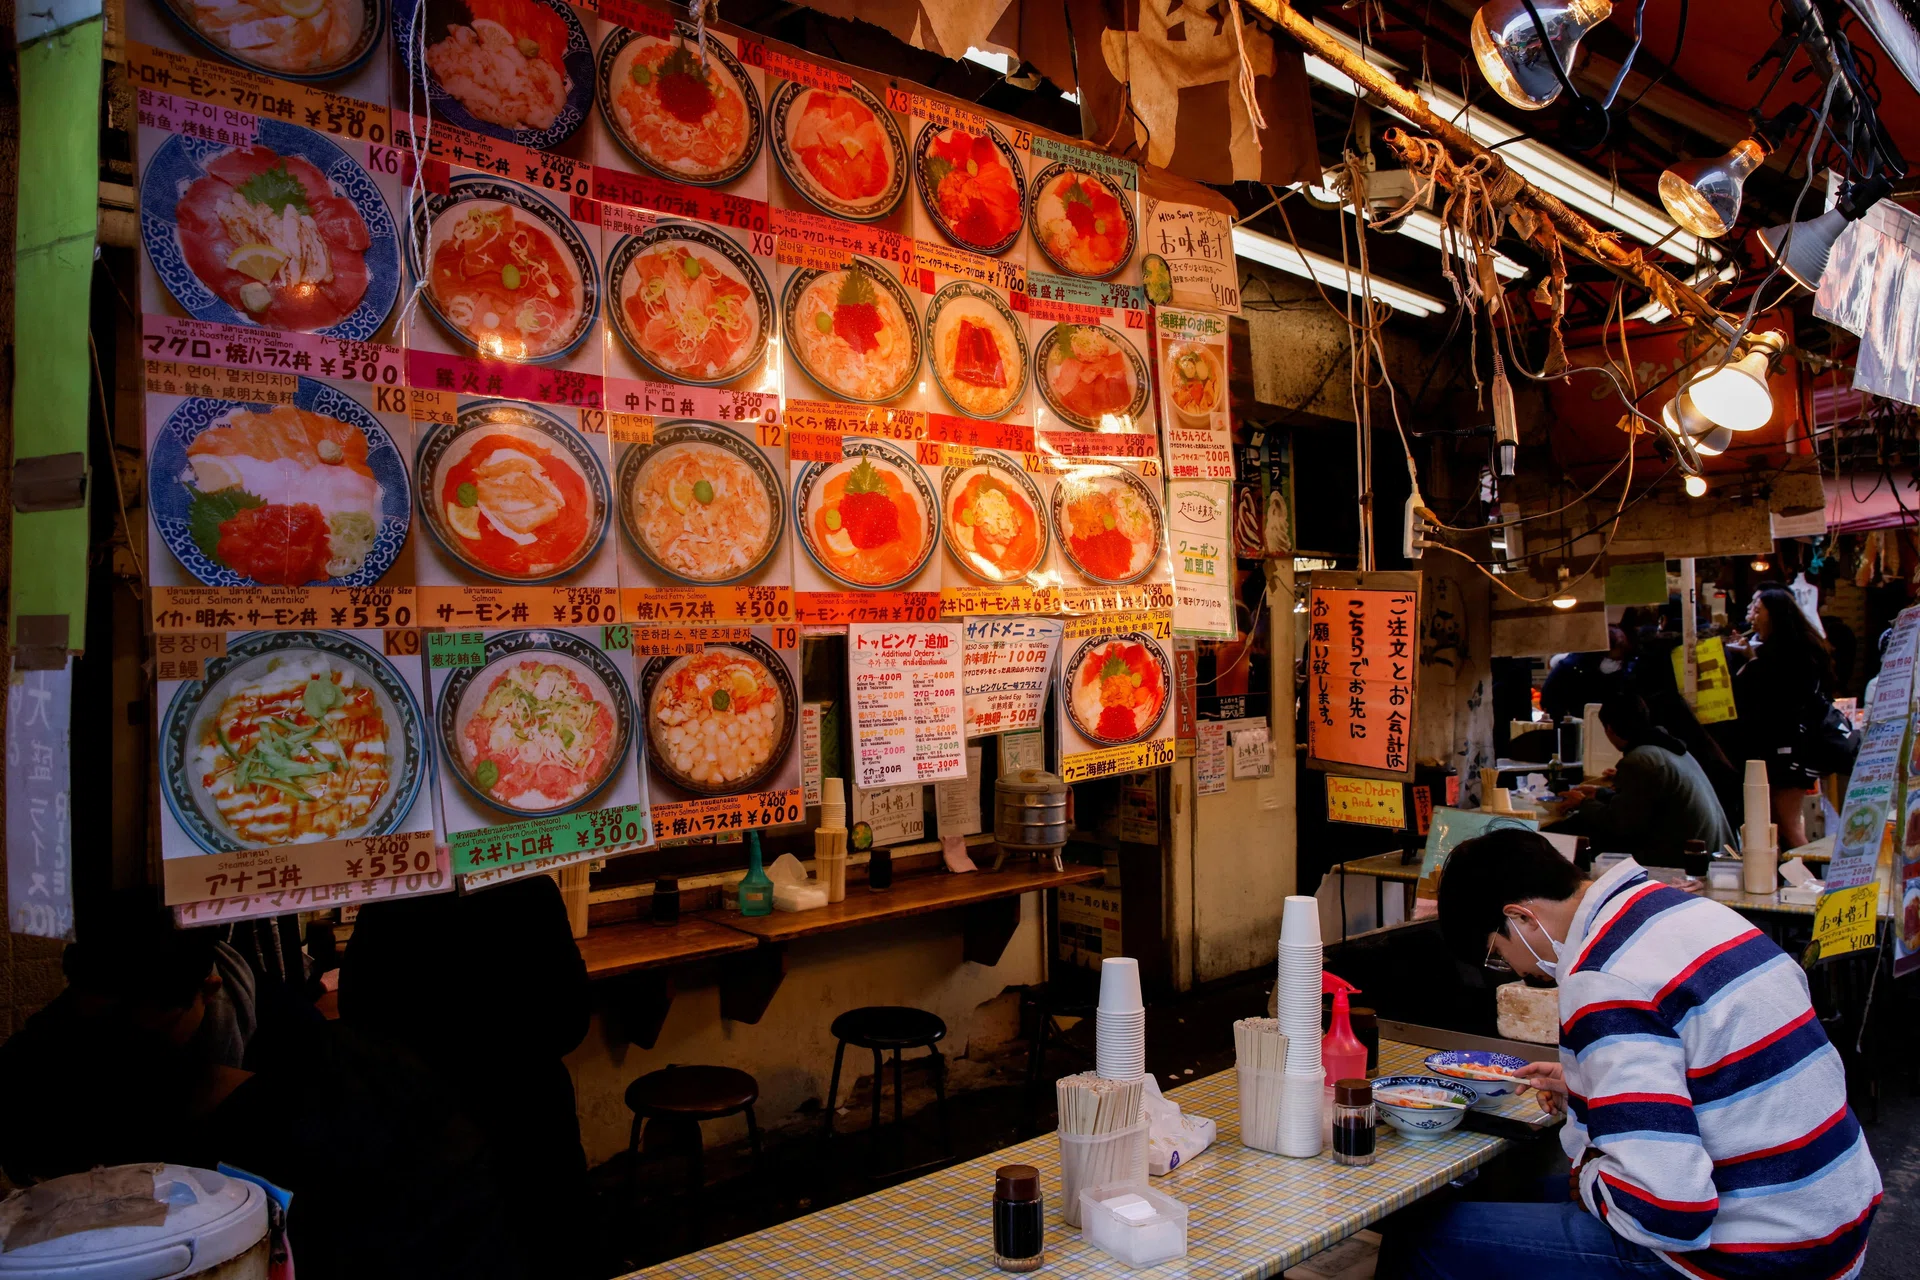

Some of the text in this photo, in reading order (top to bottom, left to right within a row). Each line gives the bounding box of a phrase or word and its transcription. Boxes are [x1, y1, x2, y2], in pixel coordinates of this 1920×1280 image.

[741, 40, 763, 66] X6
[169, 60, 260, 91] Tuna Fatty Salmon
[890, 89, 908, 112] X3
[185, 100, 217, 122] 구이
[223, 110, 255, 131] 연어
[304, 107, 385, 144] ¥500
[1014, 129, 1030, 150] Z5
[368, 146, 398, 175] K6
[526, 164, 589, 197] ¥650
[1124, 172, 1137, 191] Z1
[572, 198, 596, 223] K1
[710, 207, 765, 232] ¥700
[752, 232, 774, 256] X9
[868, 240, 911, 265] ¥650
[903, 265, 919, 287] X4
[1101, 294, 1139, 309] ¥750
[1211, 283, 1237, 307] ¥100
[1127, 310, 1144, 329] Z2
[166, 325, 294, 349] Tuna Roasted Fatty Salmon
[143, 333, 312, 371] マグロ・焼ハラス丼
[339, 348, 380, 363] ¥350
[147, 360, 181, 378] 참치,
[187, 364, 220, 382] 연어,
[320, 357, 398, 384] ¥500
[376, 386, 407, 414] K8
[410, 389, 440, 405] 연어
[539, 384, 600, 409] ¥500
[625, 392, 695, 417] 中トロ丼
[411, 408, 454, 424] 三文鱼
[581, 408, 605, 434] K2
[759, 425, 781, 447] T2
[882, 421, 923, 440] ¥650
[919, 443, 939, 465] X5
[995, 436, 1032, 452] ¥750
[1024, 453, 1041, 473] X2
[1142, 460, 1157, 476] Z3
[1179, 540, 1218, 558] クーポン
[207, 595, 243, 605] Salmon
[256, 595, 309, 605] "Mentaiko"
[350, 594, 392, 607] ¥400
[379, 587, 413, 595] Half Size
[568, 594, 601, 606] ¥350
[748, 591, 776, 601] ¥350
[155, 608, 318, 628] イカ・明太・サーモン丼
[331, 606, 411, 628] ¥550
[436, 602, 530, 623] サーモン丼
[553, 605, 616, 624] ¥500
[637, 601, 715, 619] 焼ハラス丼
[735, 601, 788, 618] ¥500
[892, 606, 937, 622] ¥700
[431, 633, 484, 647] 네기 토로
[605, 625, 629, 650] K3
[776, 627, 796, 649] T9
[967, 622, 1053, 639] サイドメニュー
[1156, 621, 1171, 640] Z4
[158, 634, 220, 654] 붕장어
[385, 630, 419, 656] K9
[881, 649, 935, 658] Additional Orders
[1348, 600, 1369, 739] こちらでお先に
[1387, 595, 1413, 769] ご注文とお会計は
[1065, 758, 1117, 779] ウニ海鮮丼
[1328, 778, 1400, 797] Please Order
[1352, 796, 1374, 808] And
[747, 805, 798, 825] ¥600
[576, 822, 638, 848] ¥500
[901, 820, 924, 835] ¥100
[469, 834, 555, 866] ネギトロ丼
[218, 854, 288, 871] Steamed Sea Eel
[345, 851, 431, 879] ¥550
[205, 864, 302, 896] アナゴ丼
[1850, 932, 1875, 950] ¥100
